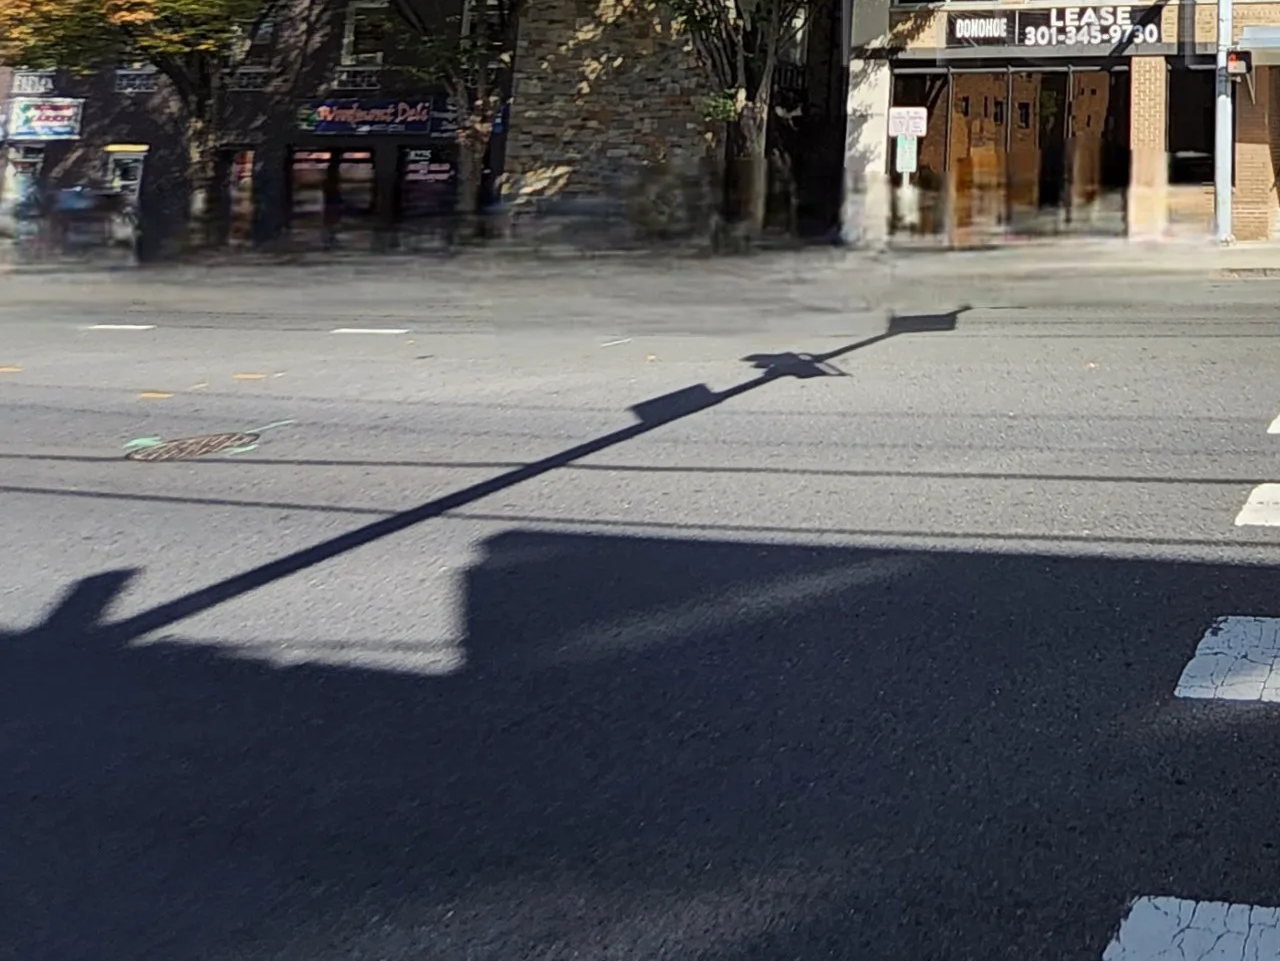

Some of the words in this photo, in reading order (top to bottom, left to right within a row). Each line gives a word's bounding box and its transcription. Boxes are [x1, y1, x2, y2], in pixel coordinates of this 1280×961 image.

[1050, 6, 1132, 27] LEASE
[955, 18, 1008, 38] DONOHOE
[1024, 23, 1159, 46] 301-345-9730
[395, 102, 429, 124] Deli
